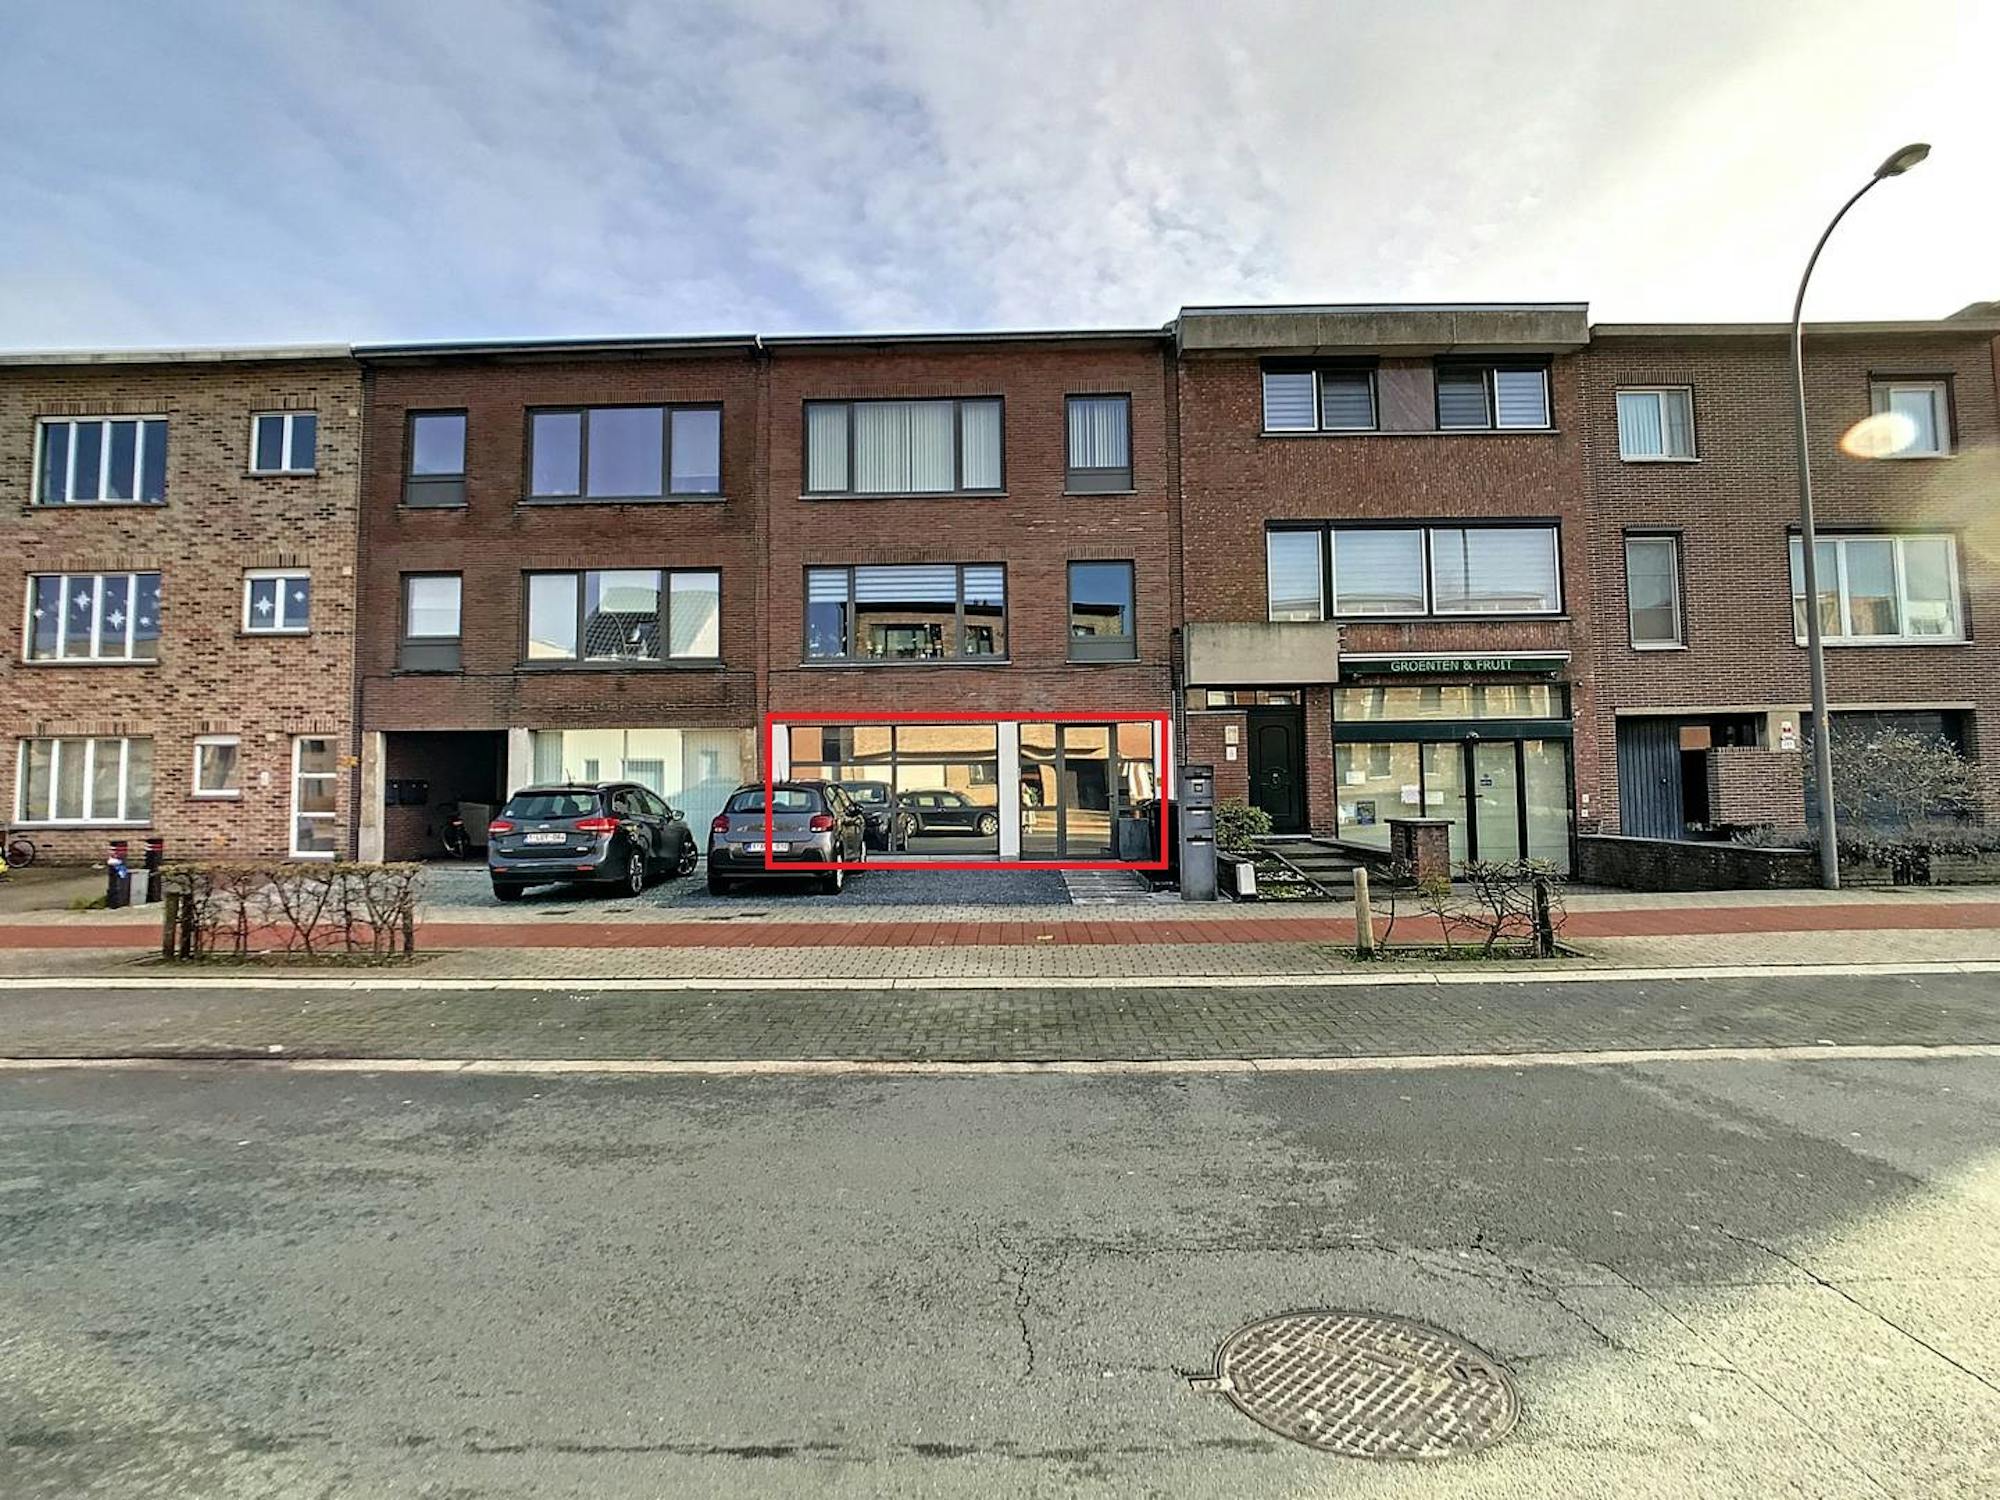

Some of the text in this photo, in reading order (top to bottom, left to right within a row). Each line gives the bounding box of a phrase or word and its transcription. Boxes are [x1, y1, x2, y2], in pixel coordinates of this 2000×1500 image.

[1390, 659, 1513, 672] GROENTEN & FRUIT
